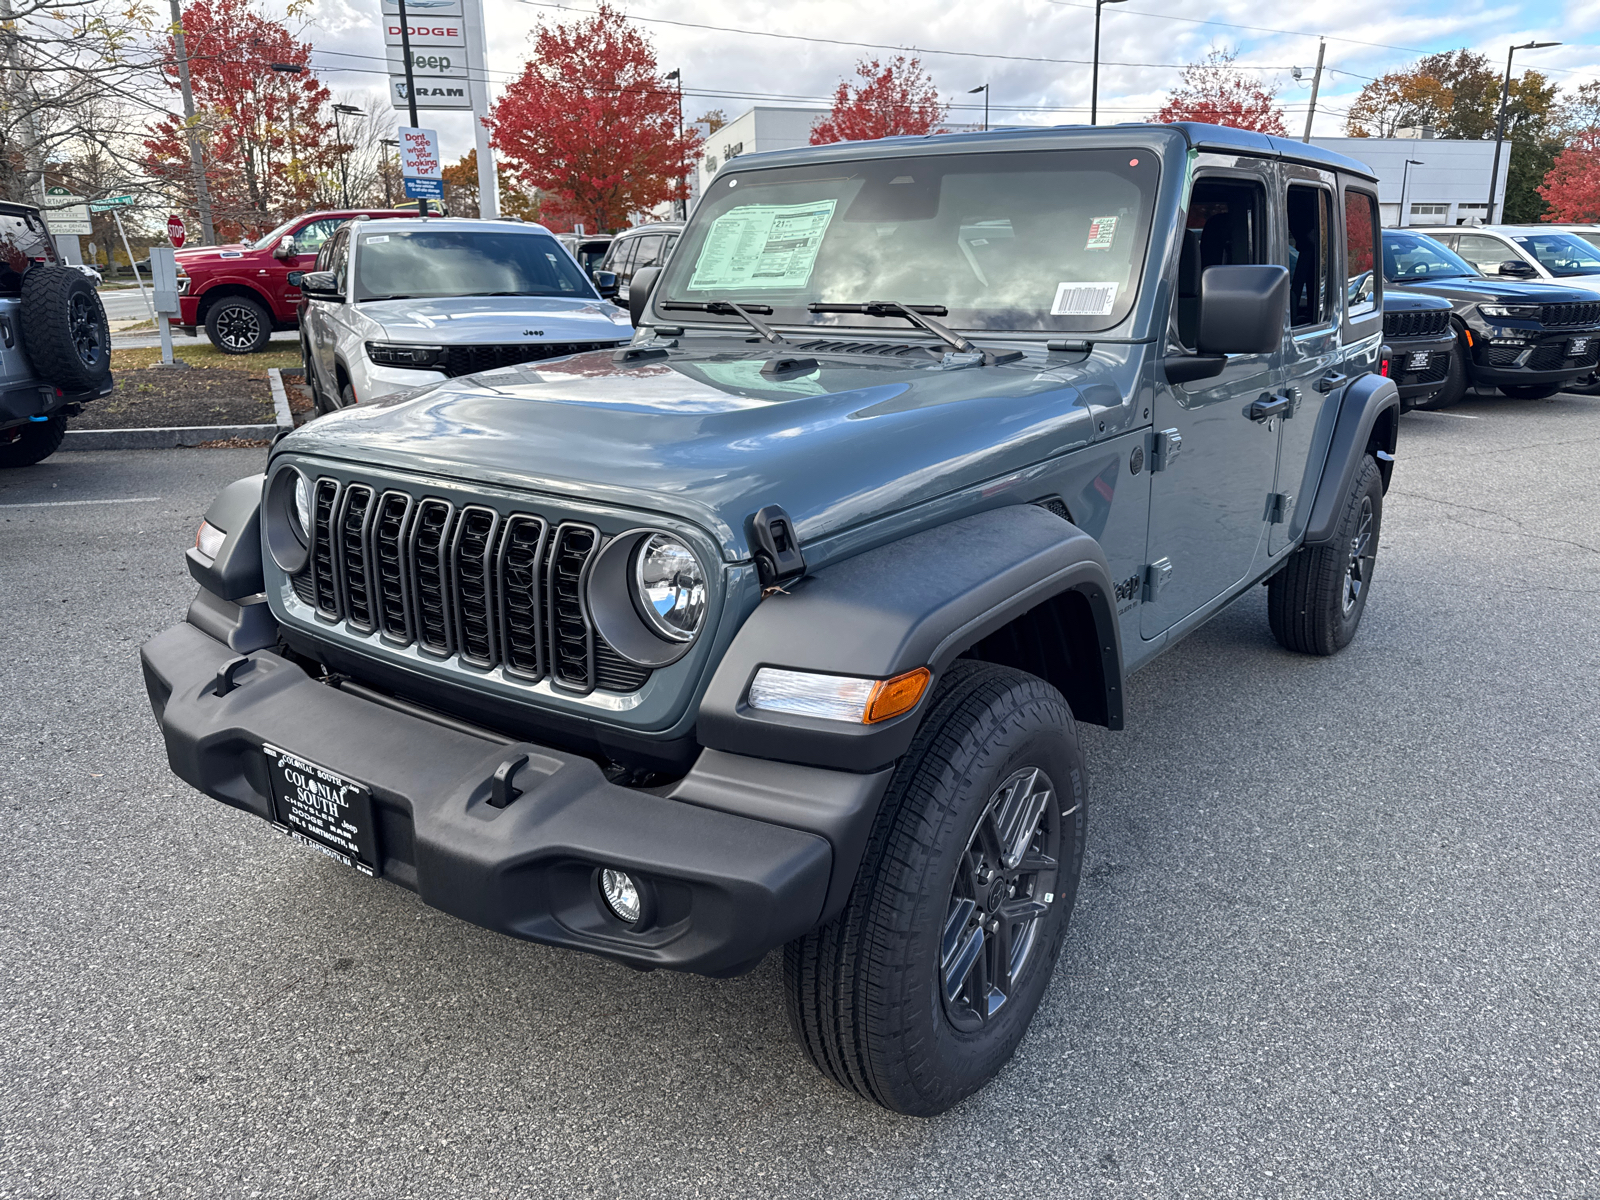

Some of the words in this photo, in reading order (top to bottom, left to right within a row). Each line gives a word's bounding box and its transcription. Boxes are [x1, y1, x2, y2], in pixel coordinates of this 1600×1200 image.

[388, 26, 458, 37] DODGE
[416, 87, 464, 97] RAM
[416, 152, 432, 160] your
[406, 159, 438, 168] looking
[417, 166, 434, 175] for?
[168, 224, 184, 238] STOP
[1113, 573, 1140, 603] eep
[317, 770, 342, 786] SOUTH
[284, 768, 349, 808] COLONIAL
[284, 795, 335, 824] CHRYSLER
[297, 787, 339, 818] SOUTH
[292, 806, 323, 827] DODGE
[330, 825, 352, 840] RAM
[341, 820, 358, 834] Jeep
[348, 842, 359, 853] MA
